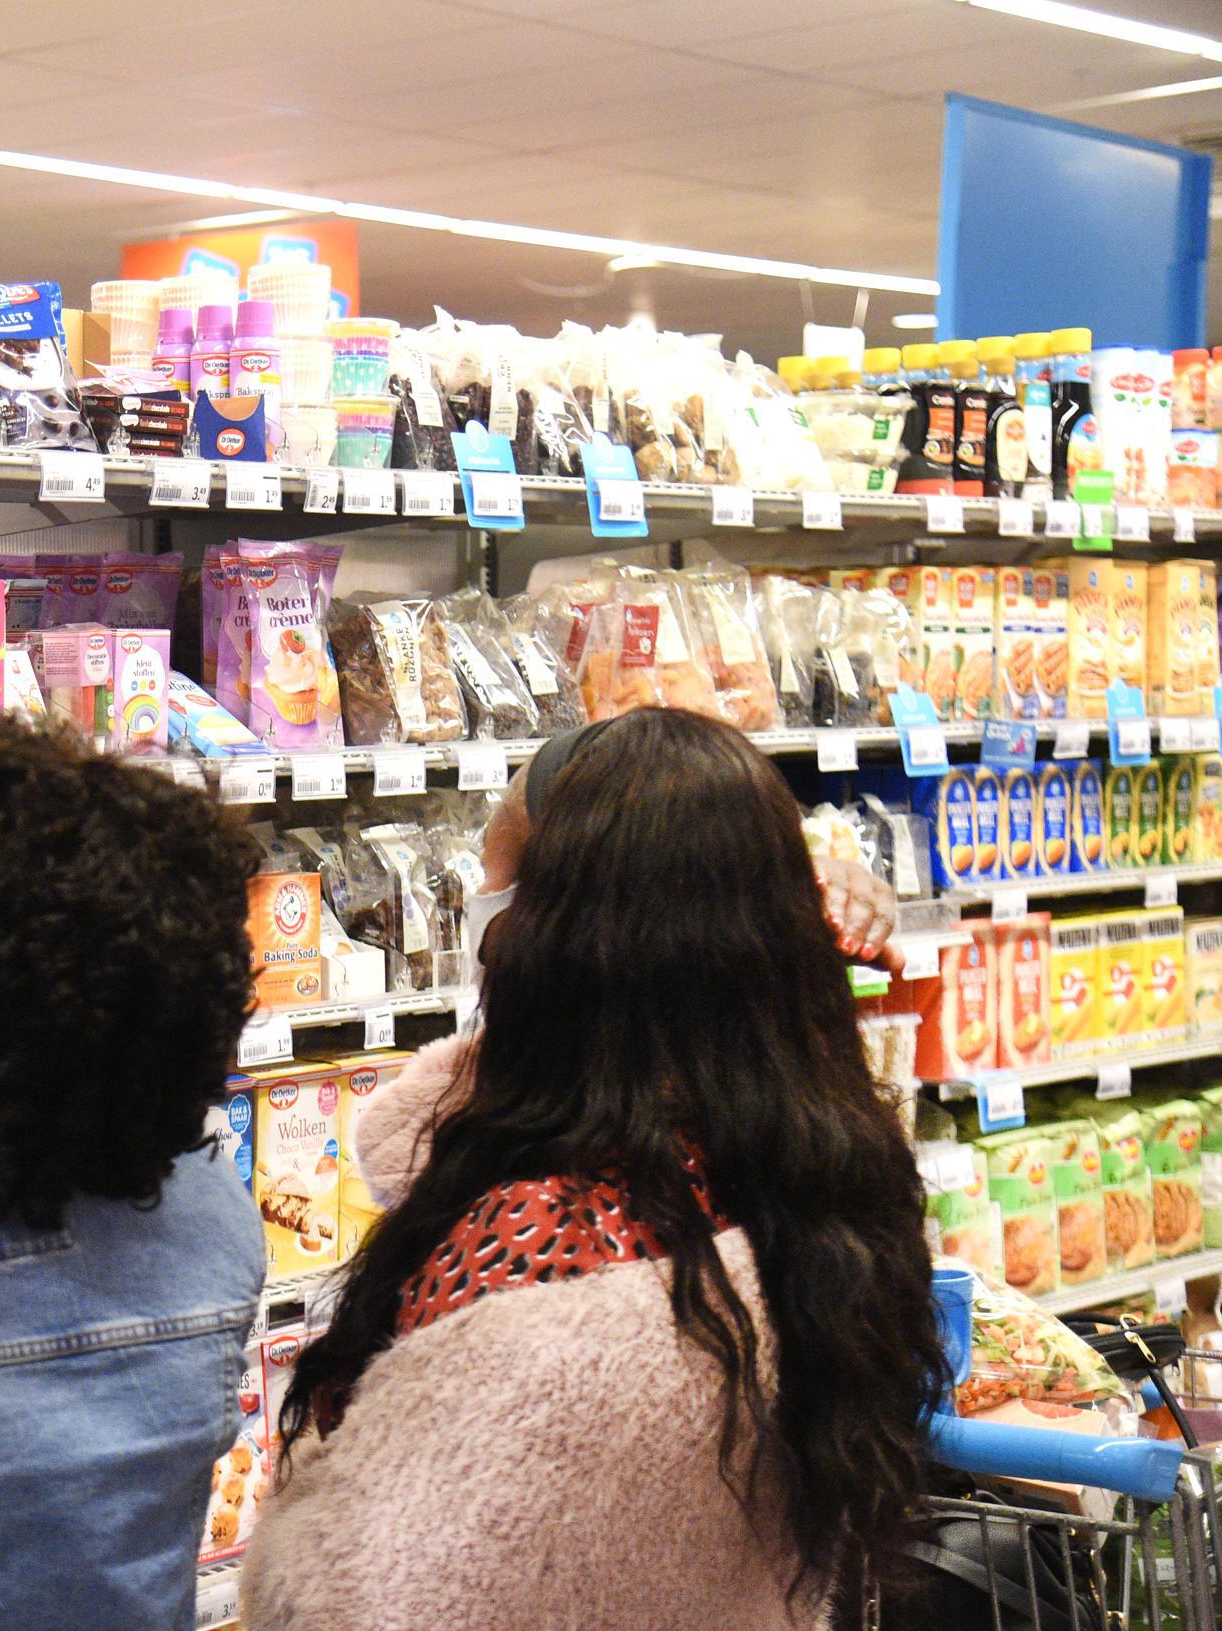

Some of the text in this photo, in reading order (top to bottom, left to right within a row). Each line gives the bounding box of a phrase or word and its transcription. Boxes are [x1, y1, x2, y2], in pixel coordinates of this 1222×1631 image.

[266, 597, 308, 611] Boter
[269, 612, 314, 628] crème
[264, 946, 318, 963] Baking Soda
[277, 1113, 327, 1141] Wolken
